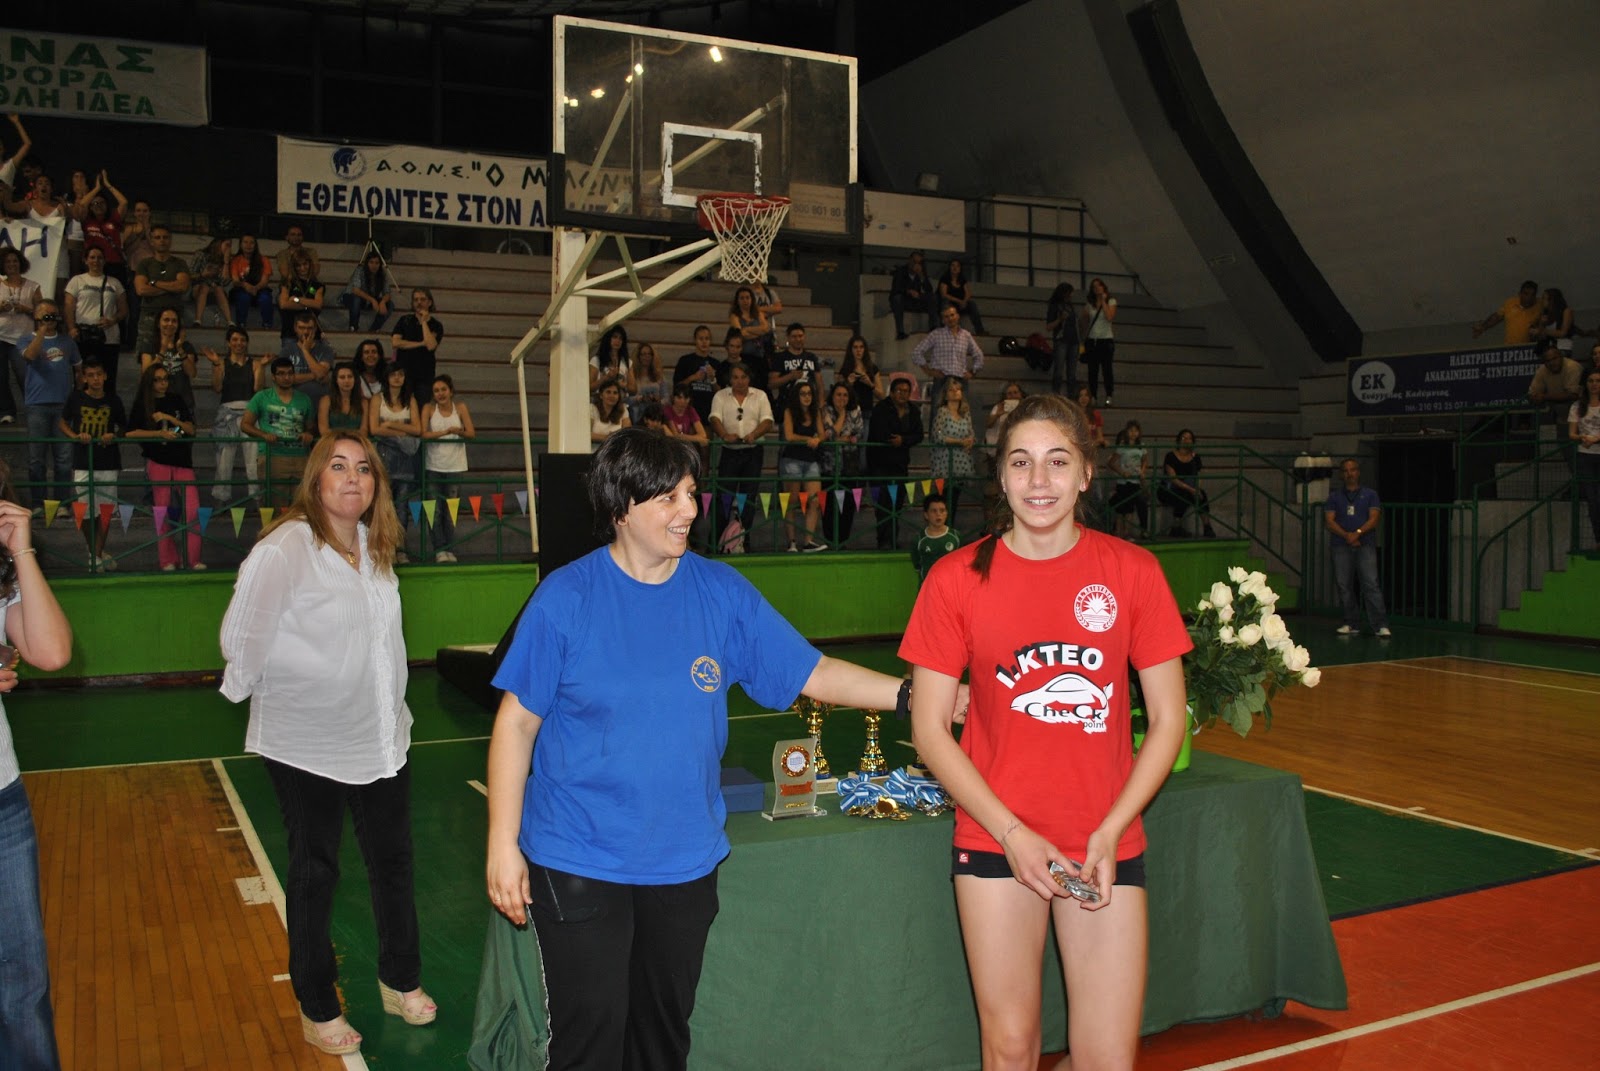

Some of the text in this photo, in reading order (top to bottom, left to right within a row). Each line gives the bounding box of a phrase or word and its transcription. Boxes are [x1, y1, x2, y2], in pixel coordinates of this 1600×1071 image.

[0, 36, 155, 74] ΝΑΣ
[76, 91, 156, 116] ΙΔΕΑ
[296, 182, 449, 220] ΕΘΕΛΟΝΤΕΣ
[457, 194, 522, 226] ΣΤΟΝ
